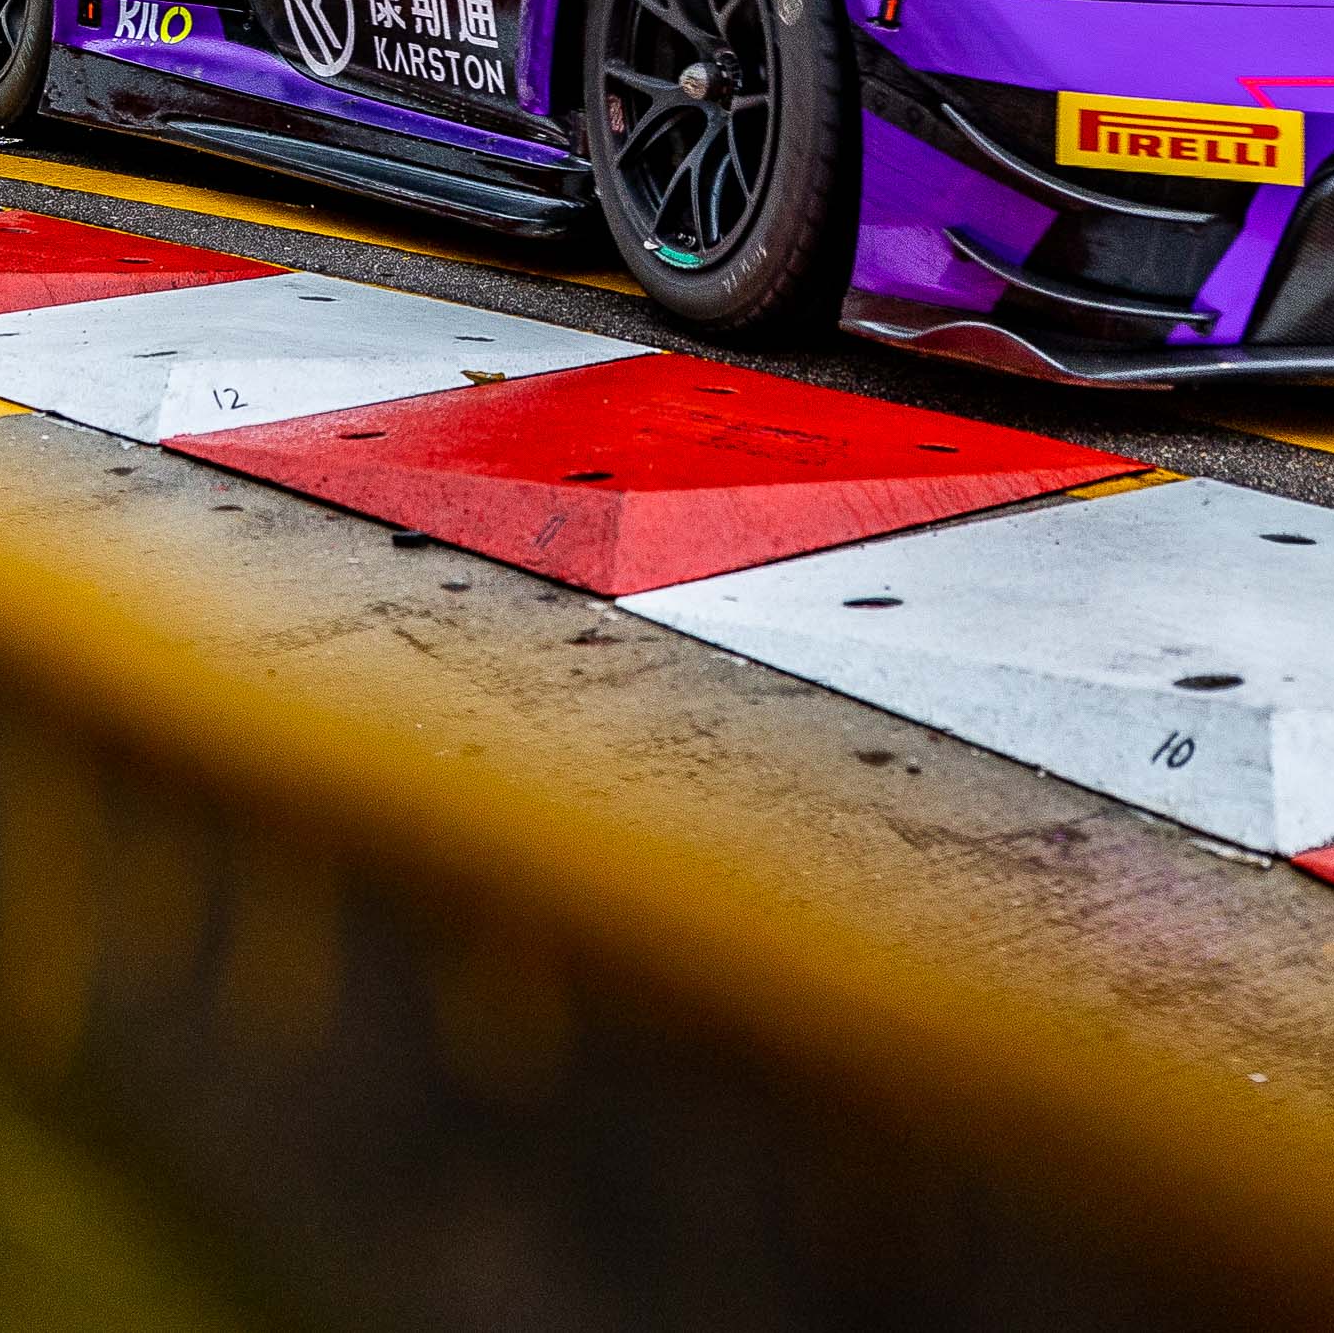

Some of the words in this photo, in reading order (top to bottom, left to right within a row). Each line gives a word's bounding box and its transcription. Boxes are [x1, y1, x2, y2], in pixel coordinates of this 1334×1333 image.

[373, 35, 506, 94] KARSTON
[1078, 109, 1281, 168] PIRELLI
[213, 388, 249, 410] 12
[1151, 730, 1195, 769] 10
